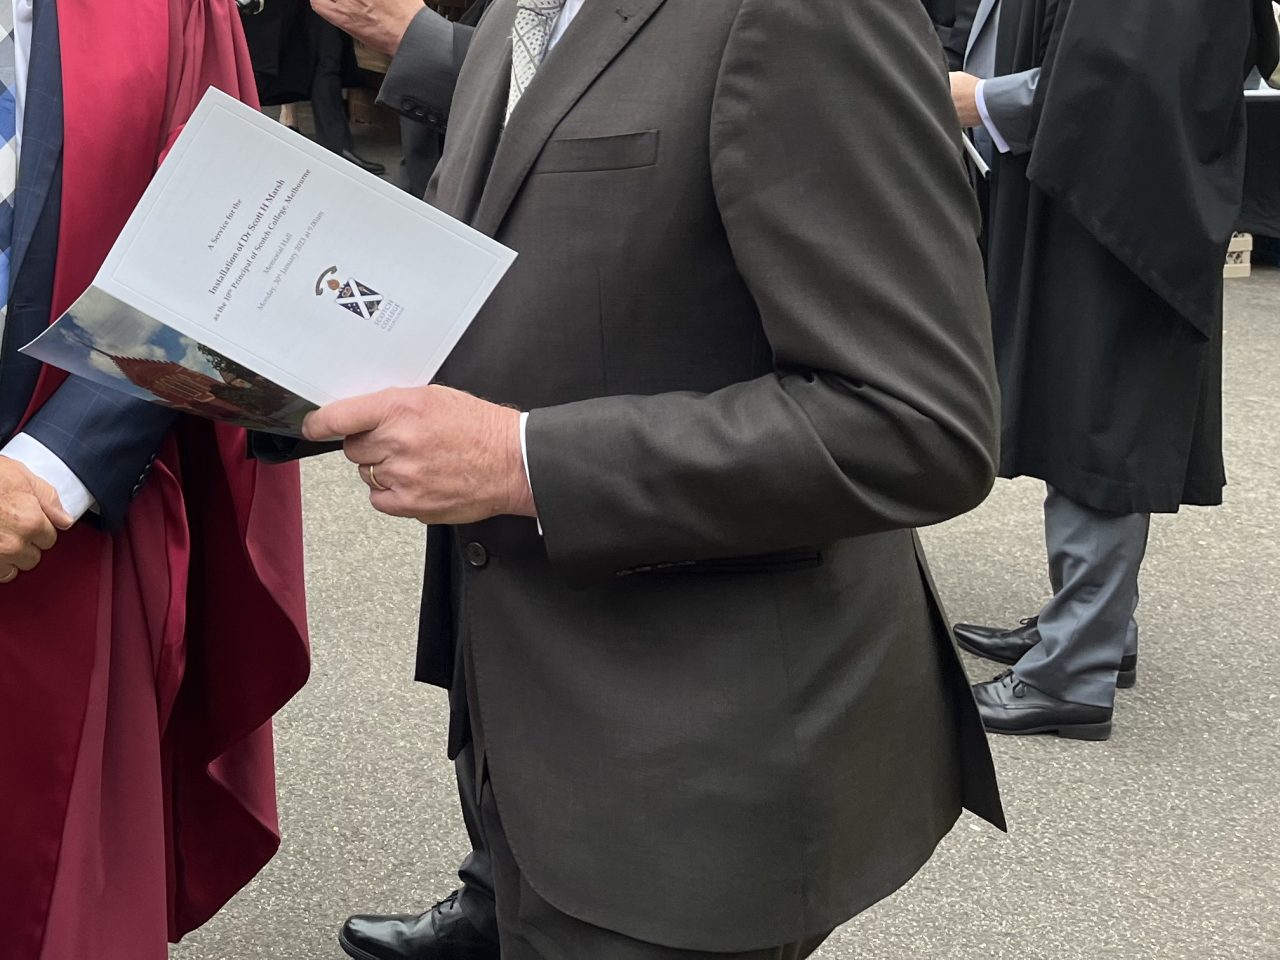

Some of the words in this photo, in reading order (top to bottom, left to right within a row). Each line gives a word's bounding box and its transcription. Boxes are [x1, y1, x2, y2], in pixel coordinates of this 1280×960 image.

[209, 252, 239, 294] Installation
[236, 241, 244, 252] of
[240, 231, 251, 243] Dr
[248, 211, 264, 231] Scott
[260, 202, 269, 212] H
[265, 179, 285, 202] Marsh
[211, 220, 229, 243] Service
[226, 210, 236, 221] for
[232, 199, 242, 210] the
[214, 313, 220, 321] as
[217, 302, 227, 313] the
[231, 259, 252, 289] Principal
[250, 250, 258, 260] of
[254, 230, 271, 251] Scotch
[268, 205, 289, 230] College,
[285, 169, 311, 202] Melbourne
[374, 299, 394, 326] SCOTCH
